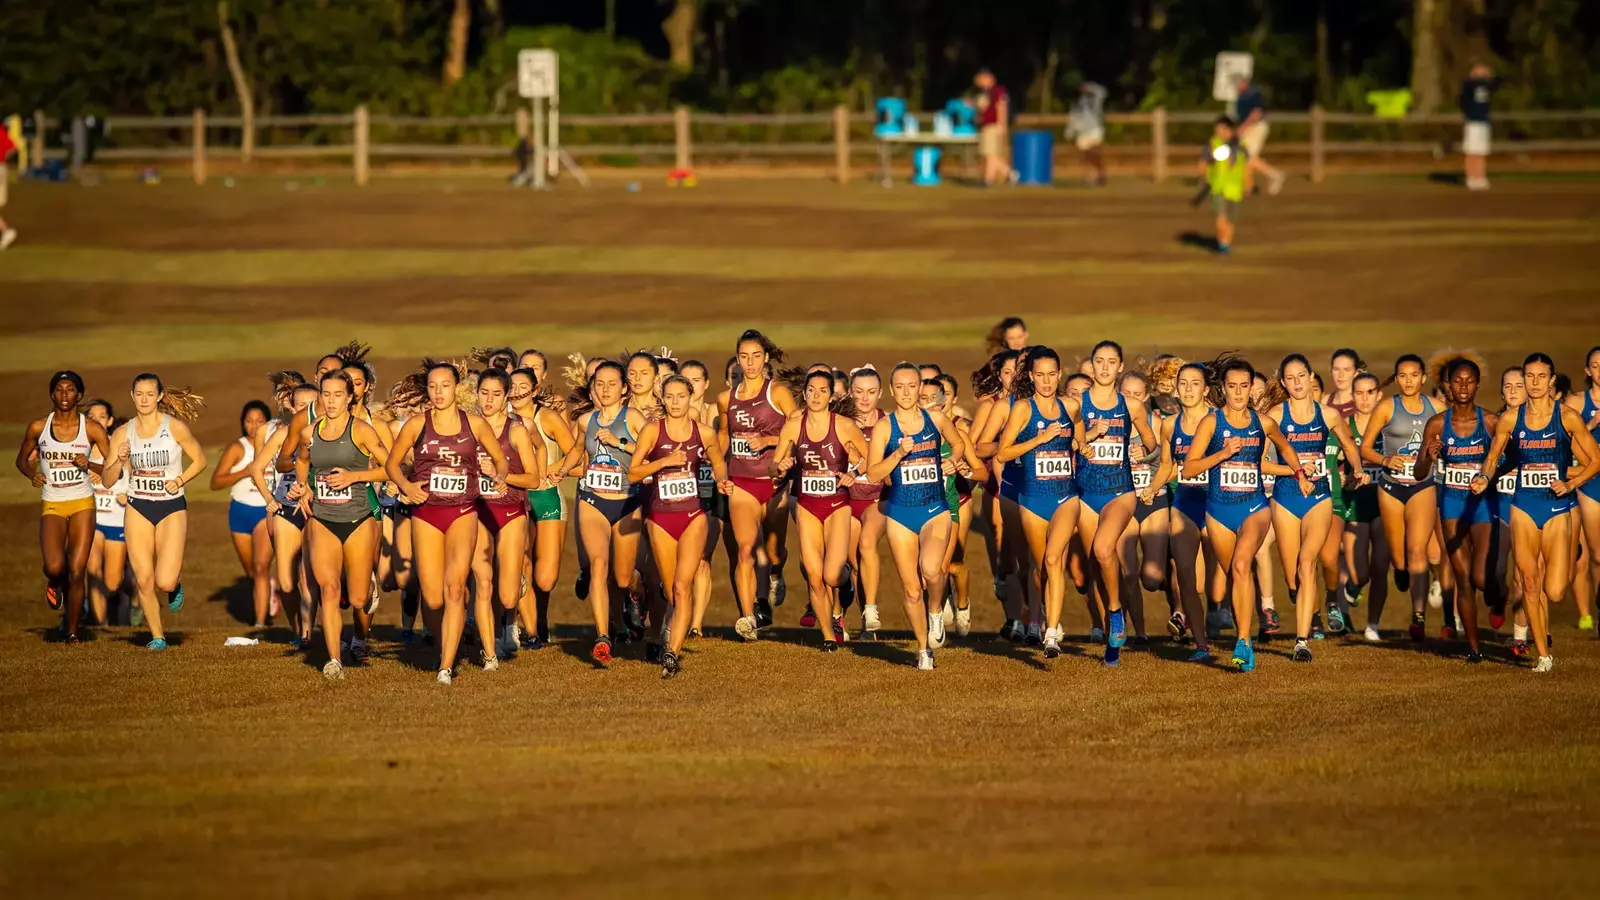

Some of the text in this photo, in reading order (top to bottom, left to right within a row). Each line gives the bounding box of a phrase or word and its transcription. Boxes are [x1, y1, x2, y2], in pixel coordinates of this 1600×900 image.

[736, 410, 755, 428] FSU
[732, 441, 751, 453] 108
[1447, 445, 1485, 456] FLORIDA
[1519, 439, 1557, 449] FLORIDA
[438, 446, 462, 467] FSU
[804, 451, 829, 470] FSU
[1037, 460, 1071, 474] 1044
[51, 470, 82, 482] 1002
[588, 473, 620, 488] 1154
[903, 467, 936, 482] 1046
[1222, 471, 1257, 485] 1048
[1447, 470, 1480, 485] 105
[1523, 473, 1557, 487] 1055
[135, 479, 165, 491] 1169
[433, 477, 466, 491] 1075
[661, 482, 696, 497] 1083
[803, 480, 835, 492] 1089
